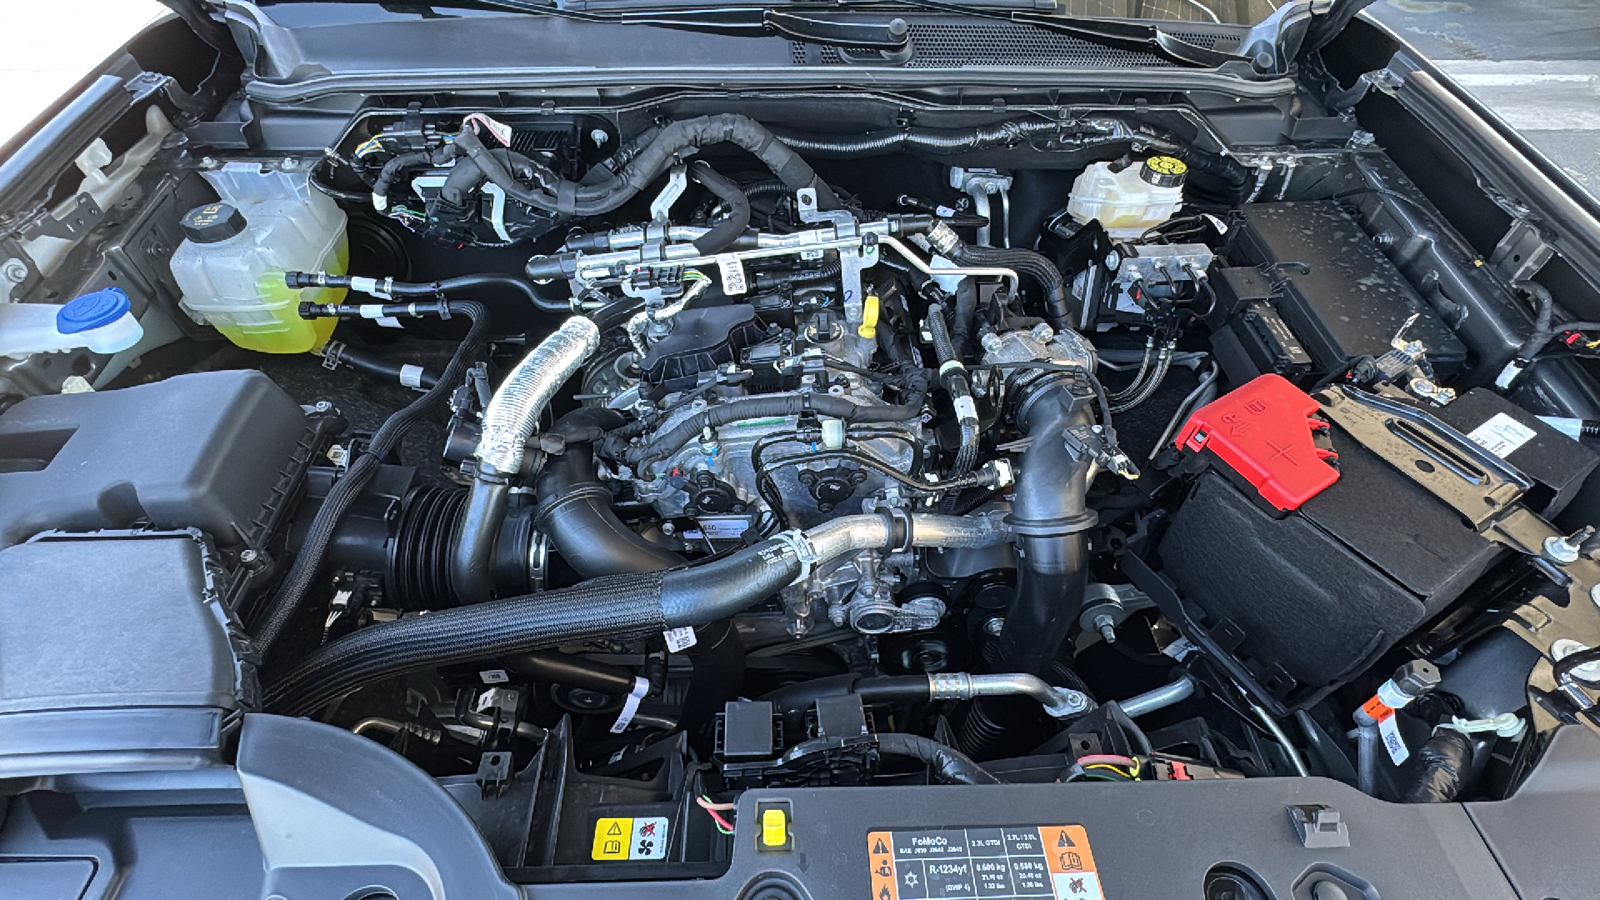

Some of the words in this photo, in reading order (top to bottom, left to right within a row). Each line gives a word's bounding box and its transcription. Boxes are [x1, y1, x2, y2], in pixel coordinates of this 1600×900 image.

[912, 836, 948, 846] FoMoCo
[929, 864, 967, 875] R-1234yf
[996, 862, 1006, 872] kg
[1033, 862, 1044, 871] kg
